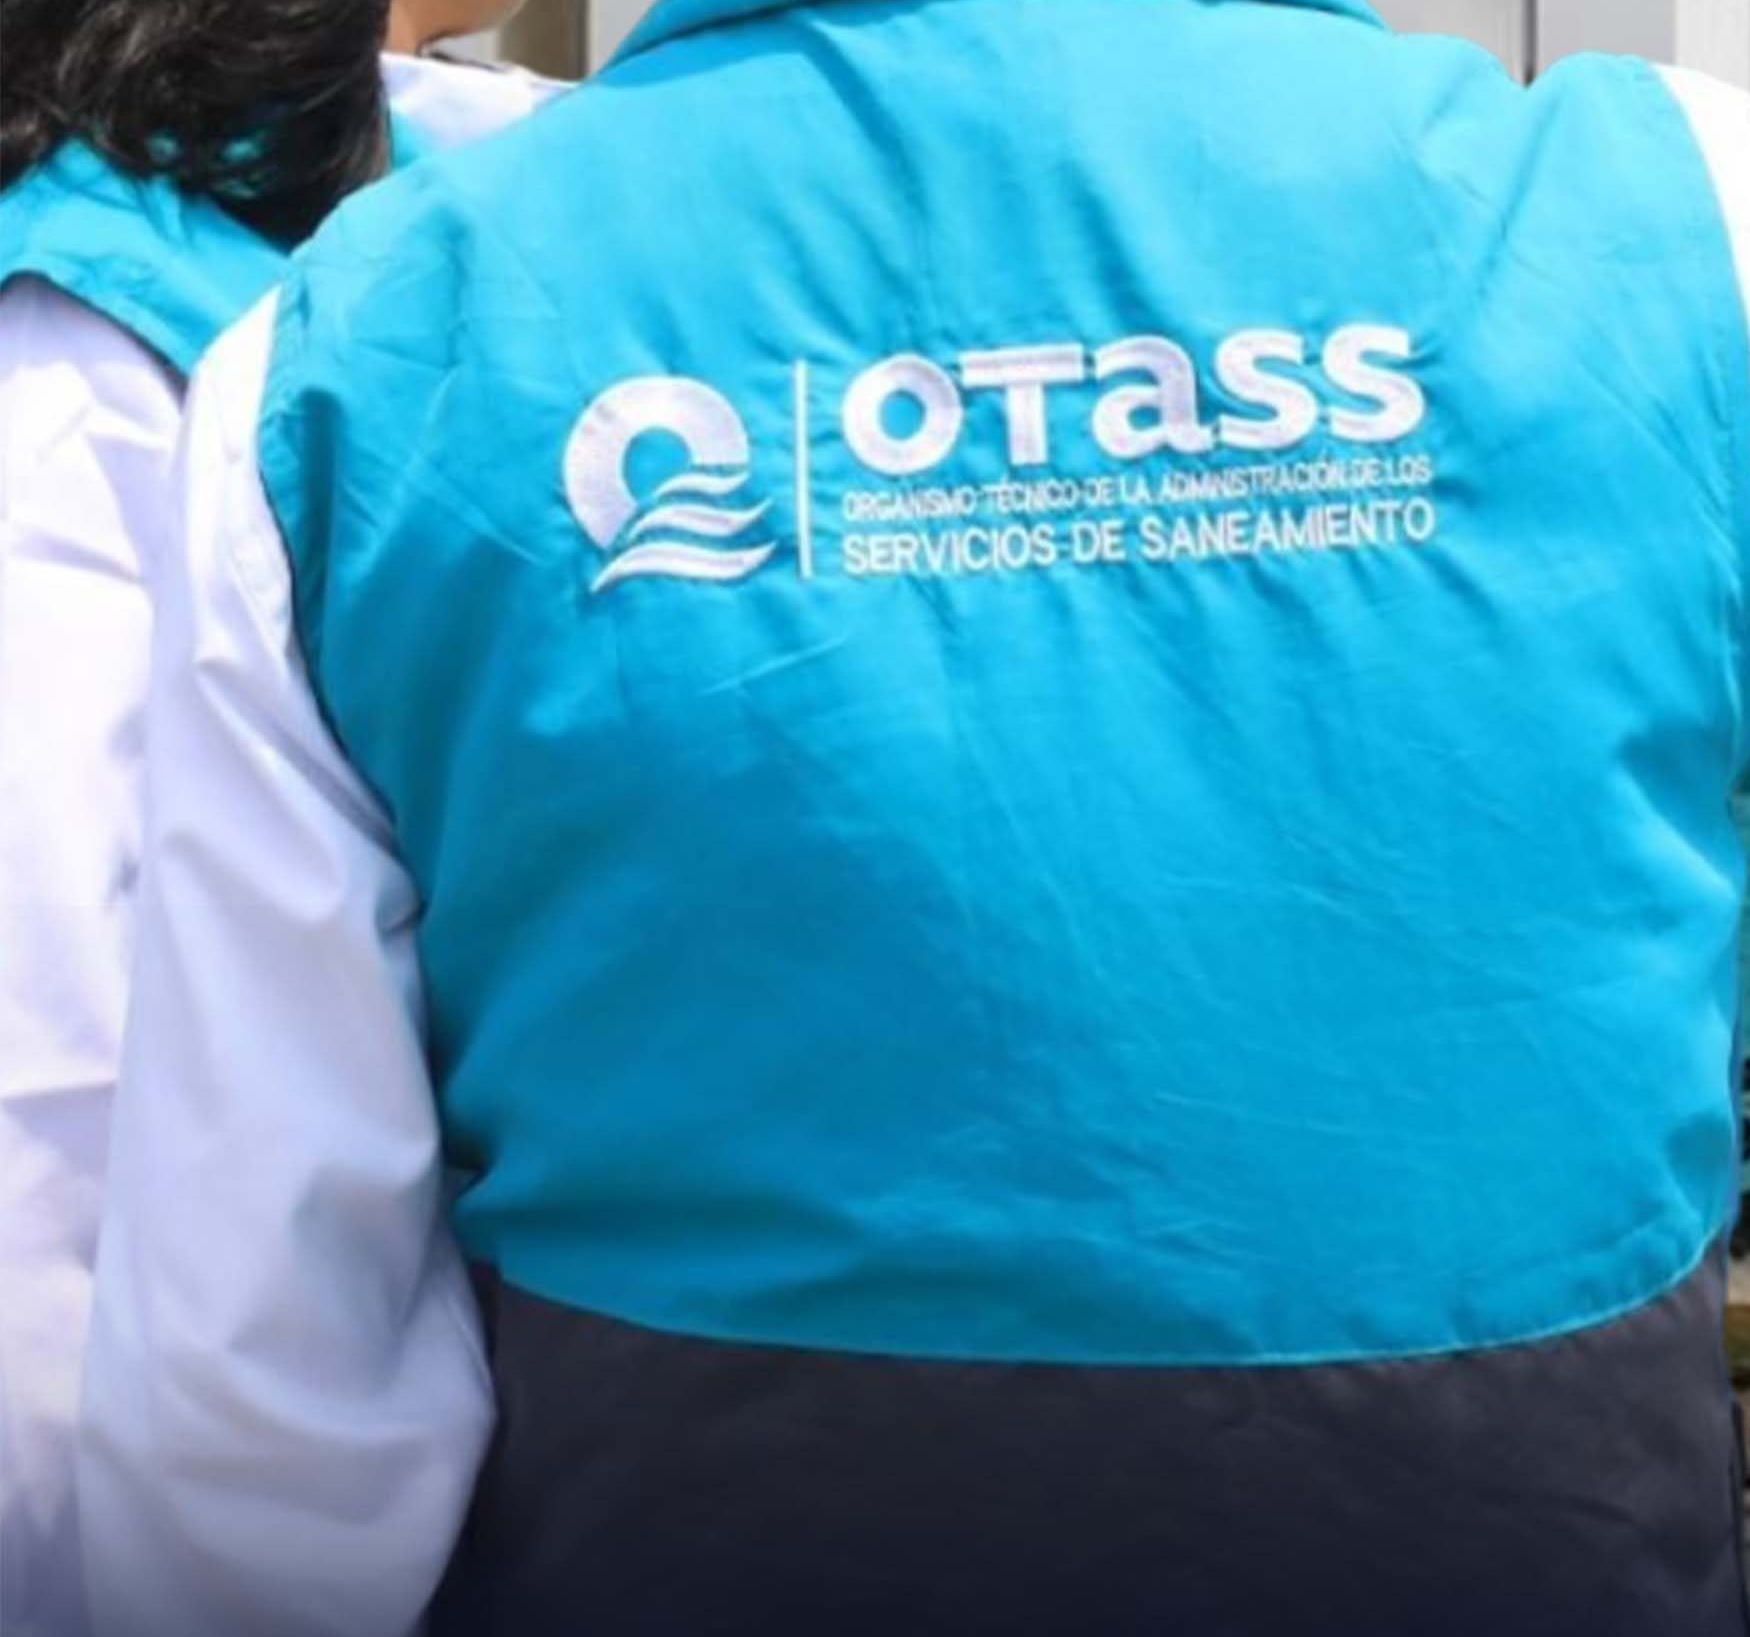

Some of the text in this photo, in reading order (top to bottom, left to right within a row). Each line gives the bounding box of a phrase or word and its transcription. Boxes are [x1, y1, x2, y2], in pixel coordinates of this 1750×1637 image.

[842, 496, 1436, 576] SERVICIOS DE SANEAMIENTO
